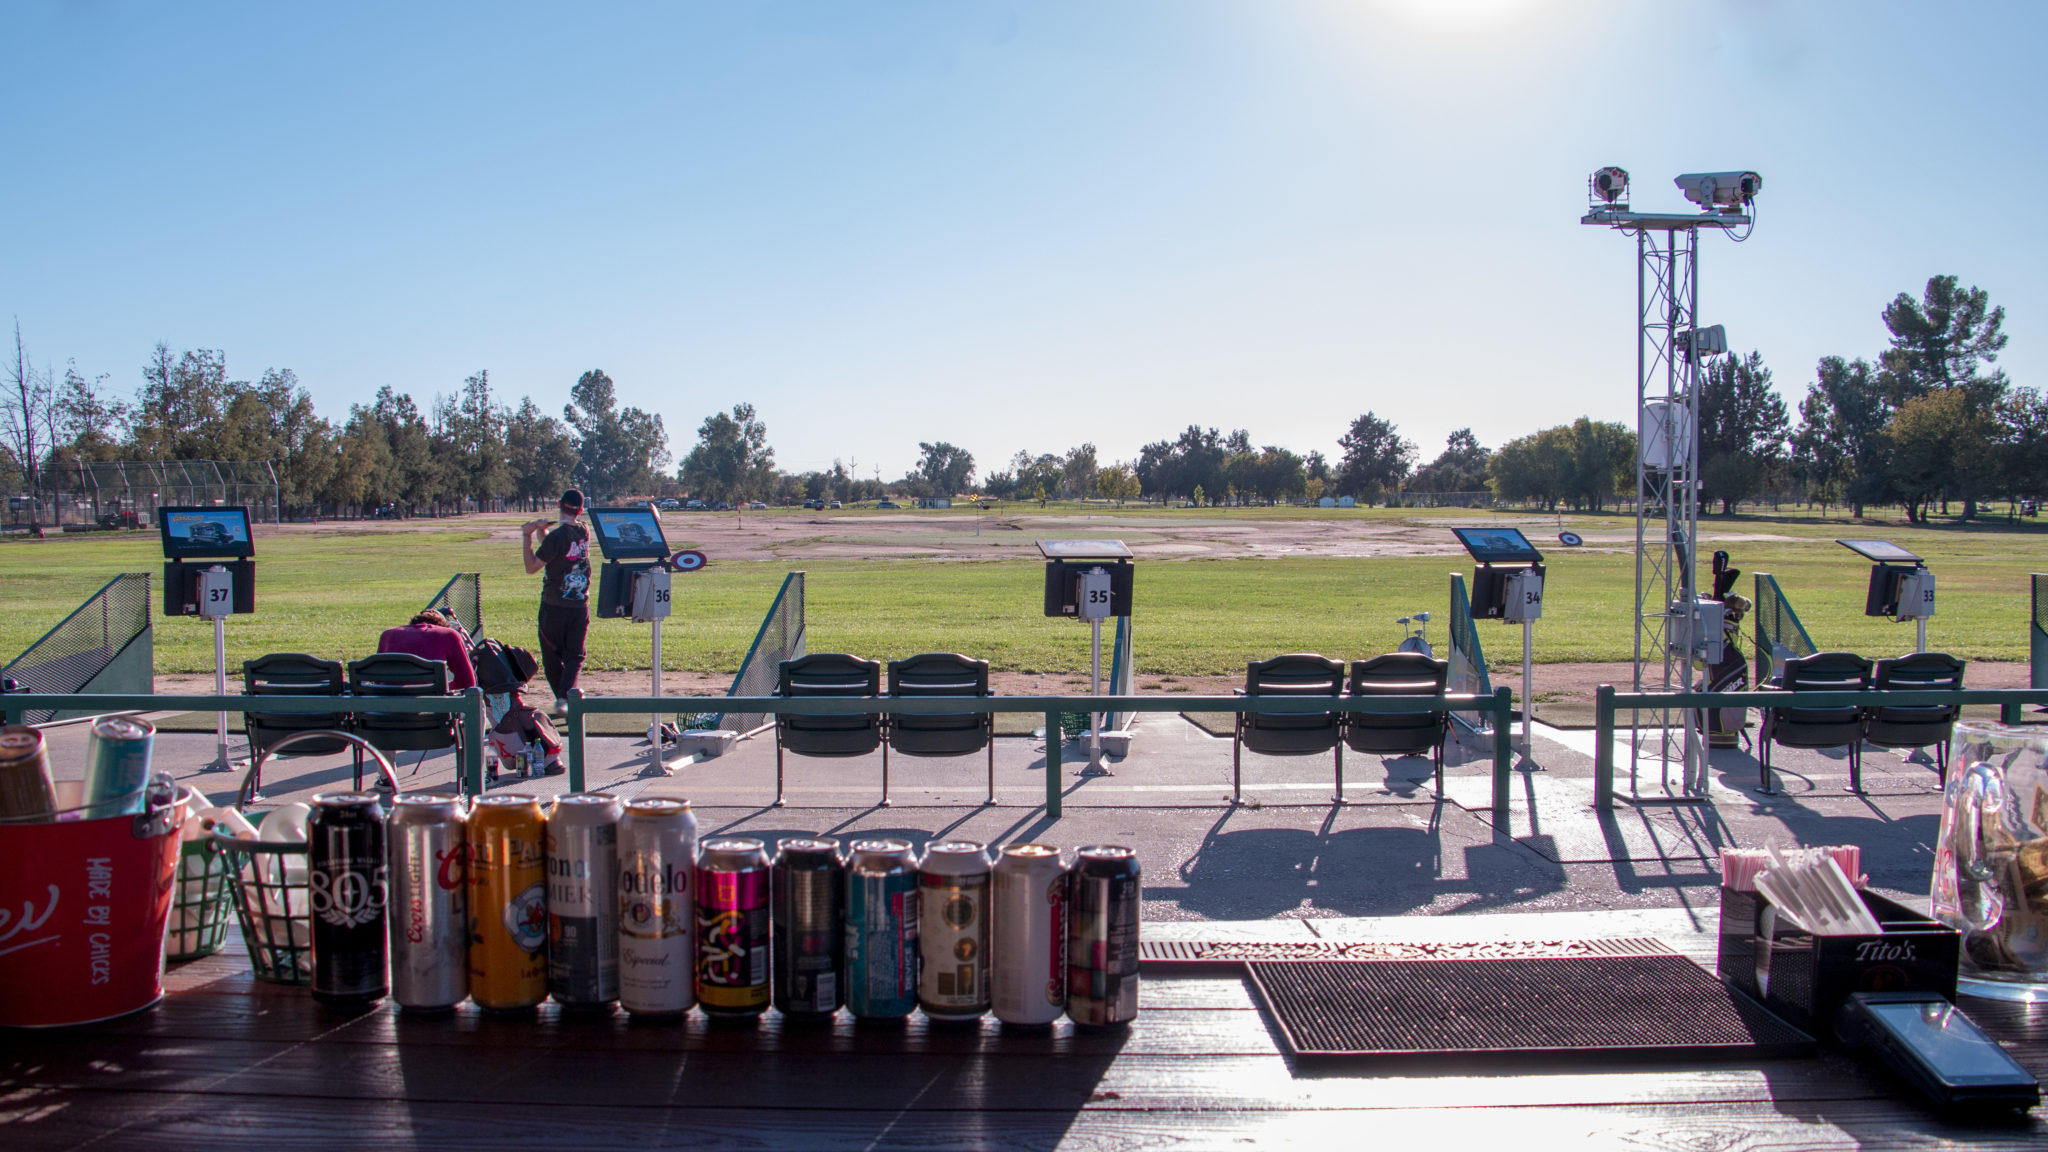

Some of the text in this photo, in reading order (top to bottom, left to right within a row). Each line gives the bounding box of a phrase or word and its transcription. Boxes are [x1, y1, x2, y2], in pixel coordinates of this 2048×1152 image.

[210, 589, 228, 602] 37
[656, 590, 670, 603] 36
[1089, 590, 1108, 603] 35
[1526, 592, 1540, 604] 34
[1923, 590, 1934, 602] 33
[617, 858, 687, 894] odelo
[310, 866, 389, 912] 805
[83, 857, 113, 985] MADE BY CHICKS
[406, 898, 422, 943] Coors
